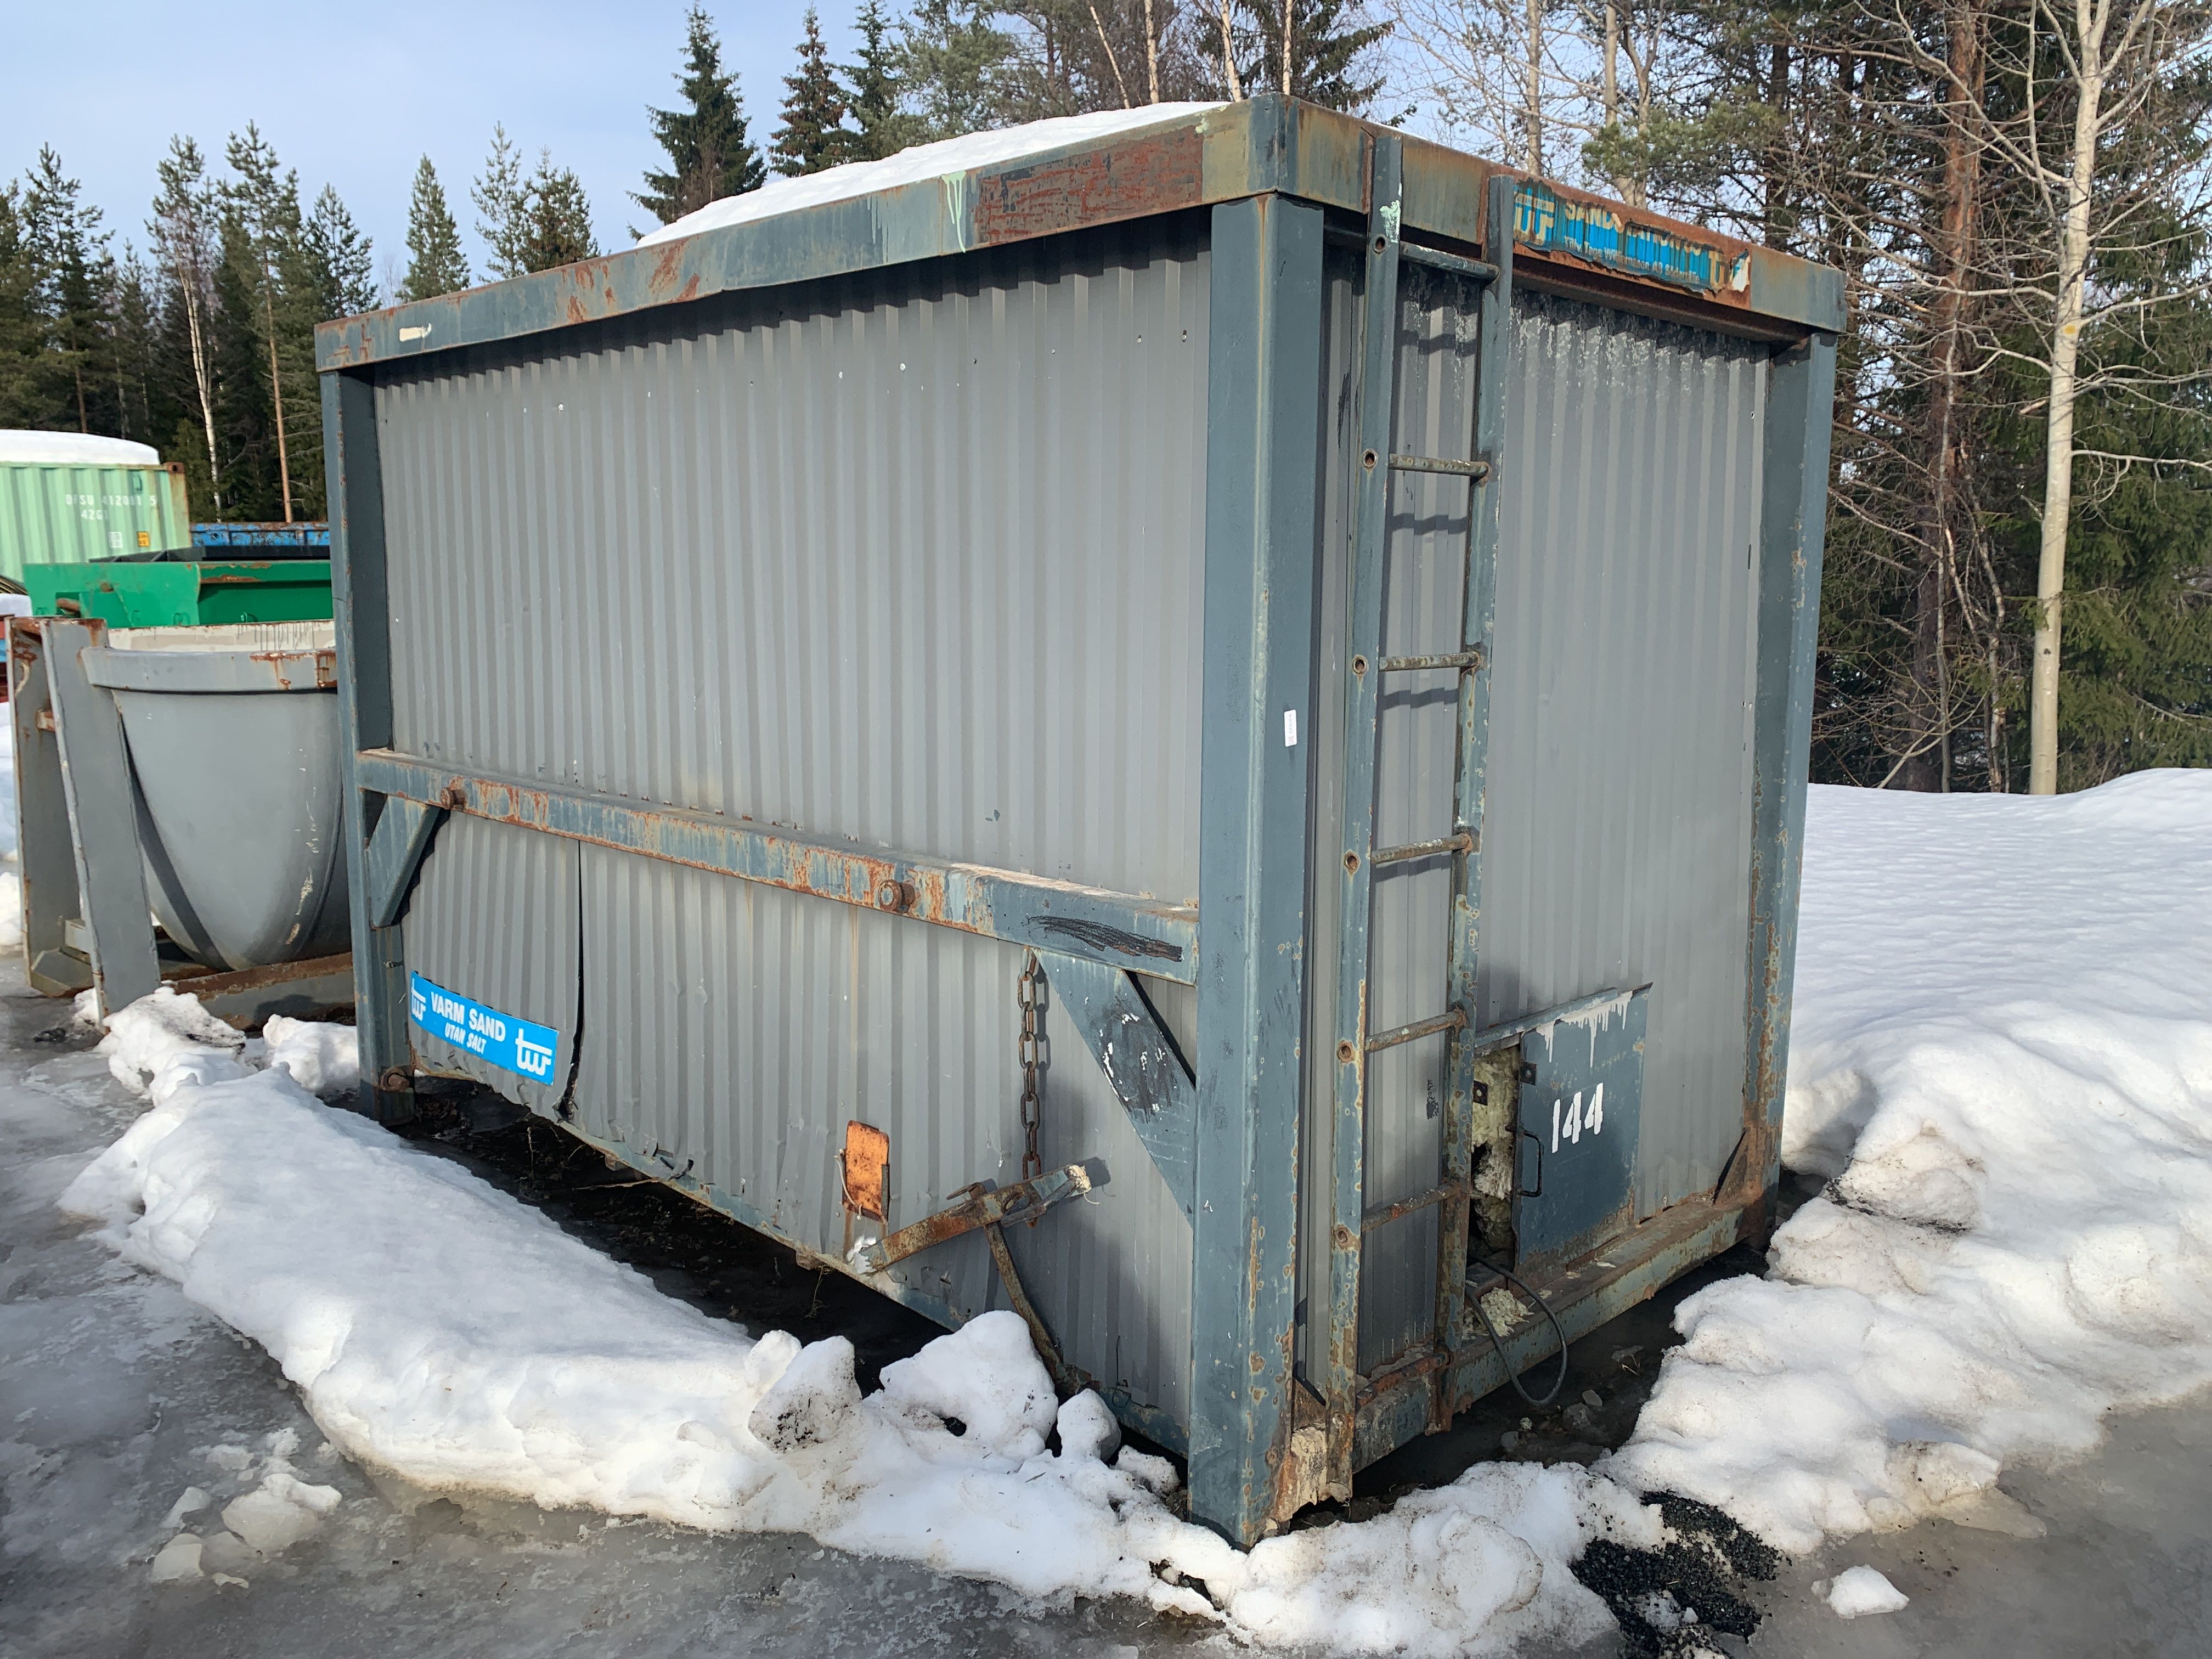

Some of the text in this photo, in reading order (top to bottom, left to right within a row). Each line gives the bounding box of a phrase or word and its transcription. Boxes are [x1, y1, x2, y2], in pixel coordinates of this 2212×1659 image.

[149, 495, 157, 507] 5
[431, 991, 506, 1042] VARM SAND
[445, 1022, 487, 1054] UTAN SALT
[1552, 1082, 1603, 1154] 144
